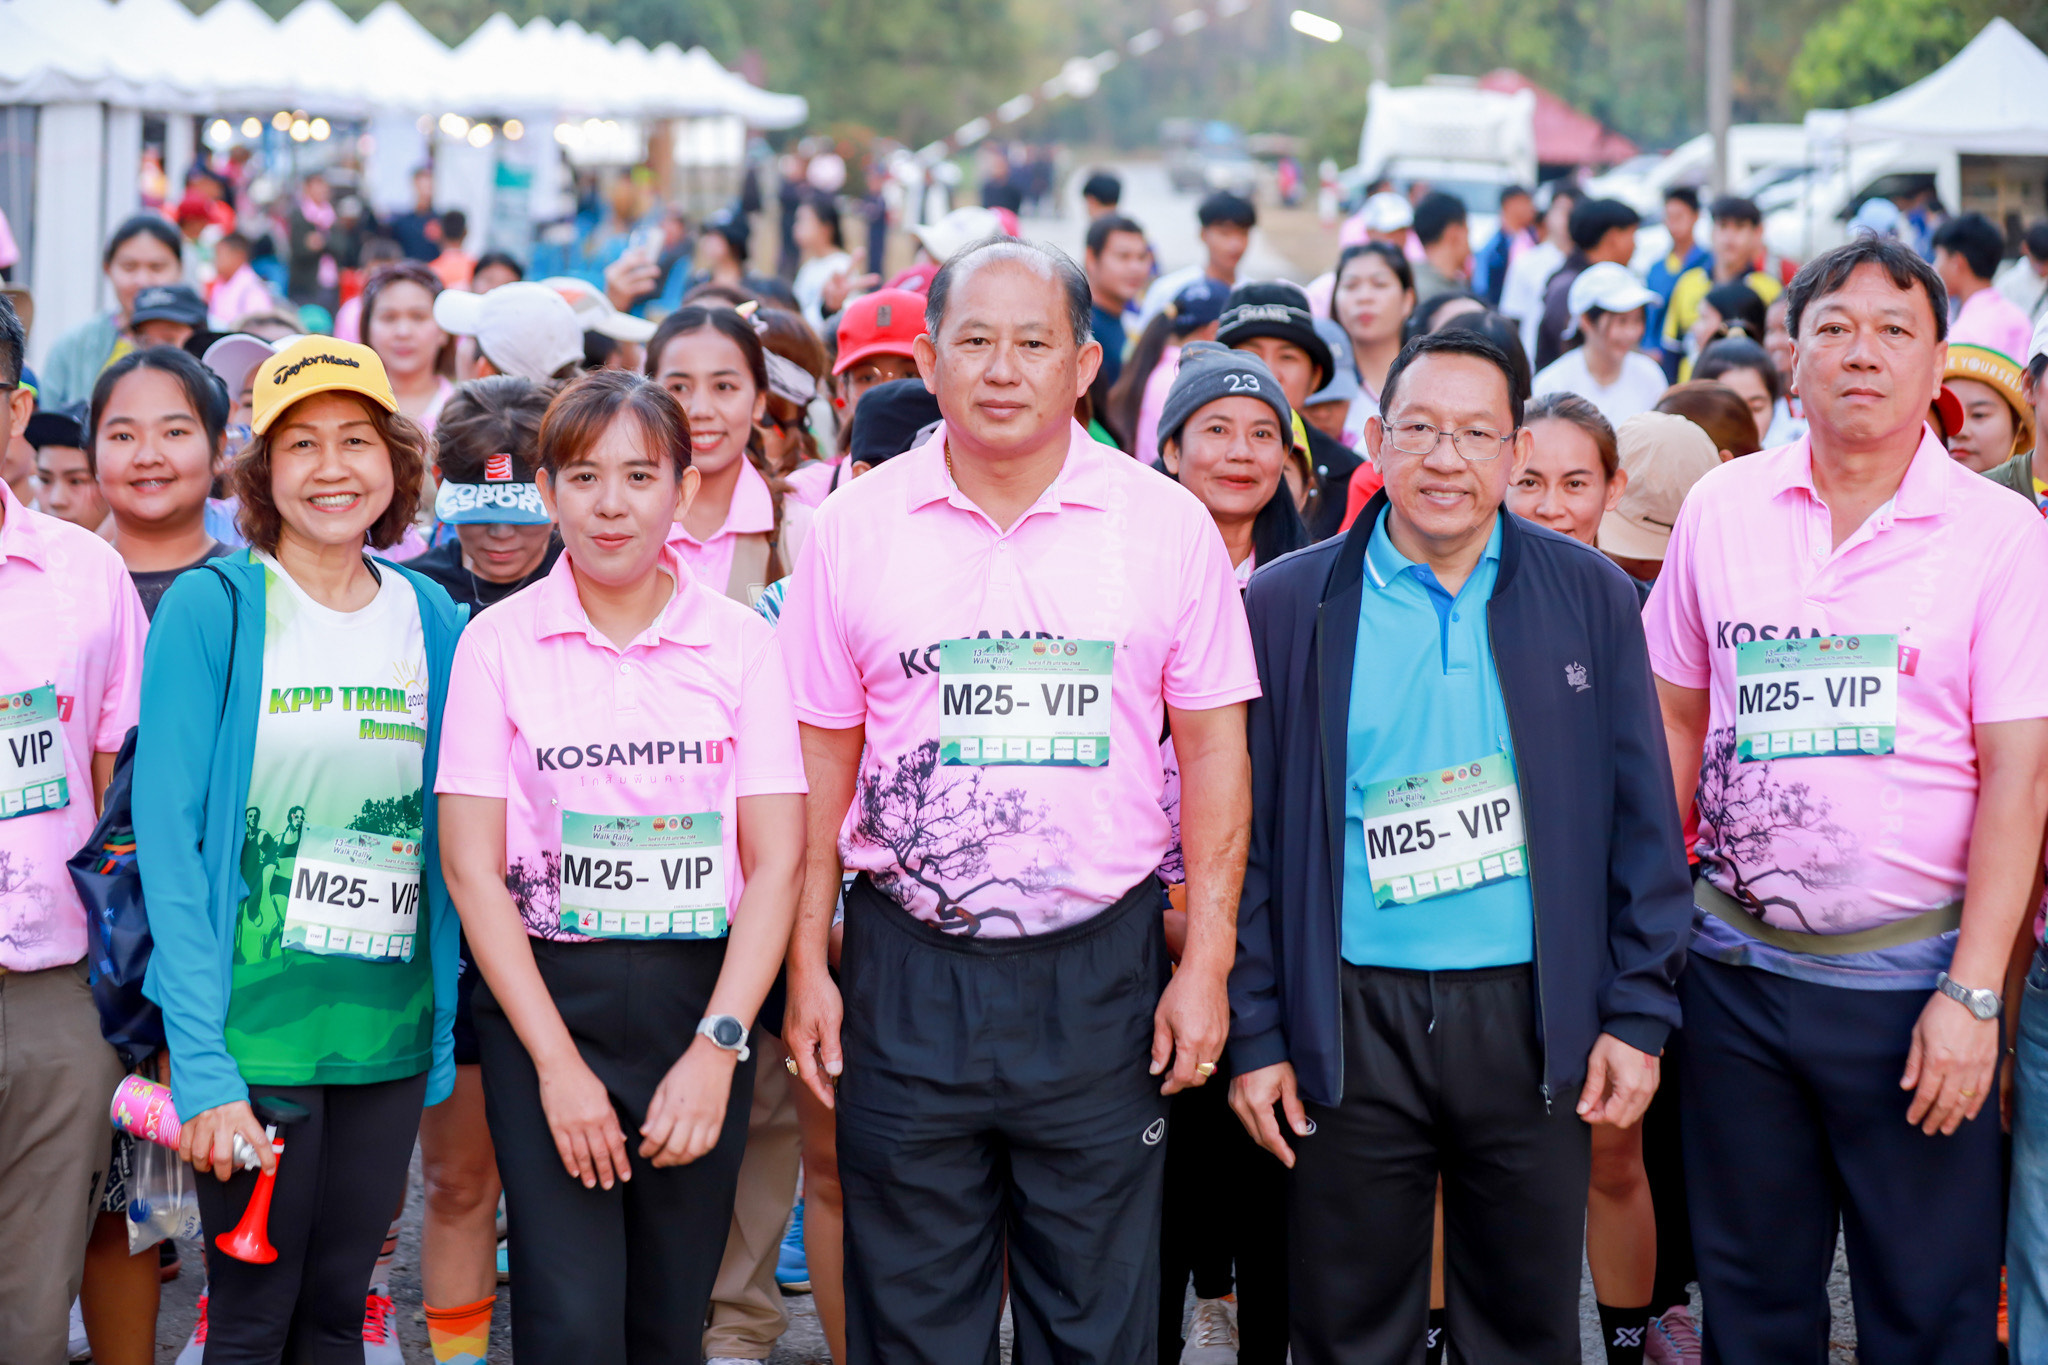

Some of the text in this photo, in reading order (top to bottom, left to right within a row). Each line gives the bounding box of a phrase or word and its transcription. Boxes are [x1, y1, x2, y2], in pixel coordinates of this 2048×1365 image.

[273, 354, 360, 385] TaylorMade
[1223, 374, 1260, 392] 23
[973, 657, 991, 665] Walk
[993, 657, 1010, 666] Rally
[269, 686, 333, 714] KPP
[339, 686, 411, 714] TRAIL
[944, 683, 1099, 716] M25- VIP
[1739, 676, 1881, 715] M25- VIP
[8, 730, 53, 768] VIP
[359, 718, 426, 749] Running
[1388, 793, 1424, 805] Walk Rally
[611, 834, 631, 842] Rally
[1367, 798, 1510, 860] M25- VIP
[334, 846, 371, 860] Walk Rally
[564, 853, 713, 890] M25- VIP
[295, 867, 419, 915] M25- VIP
